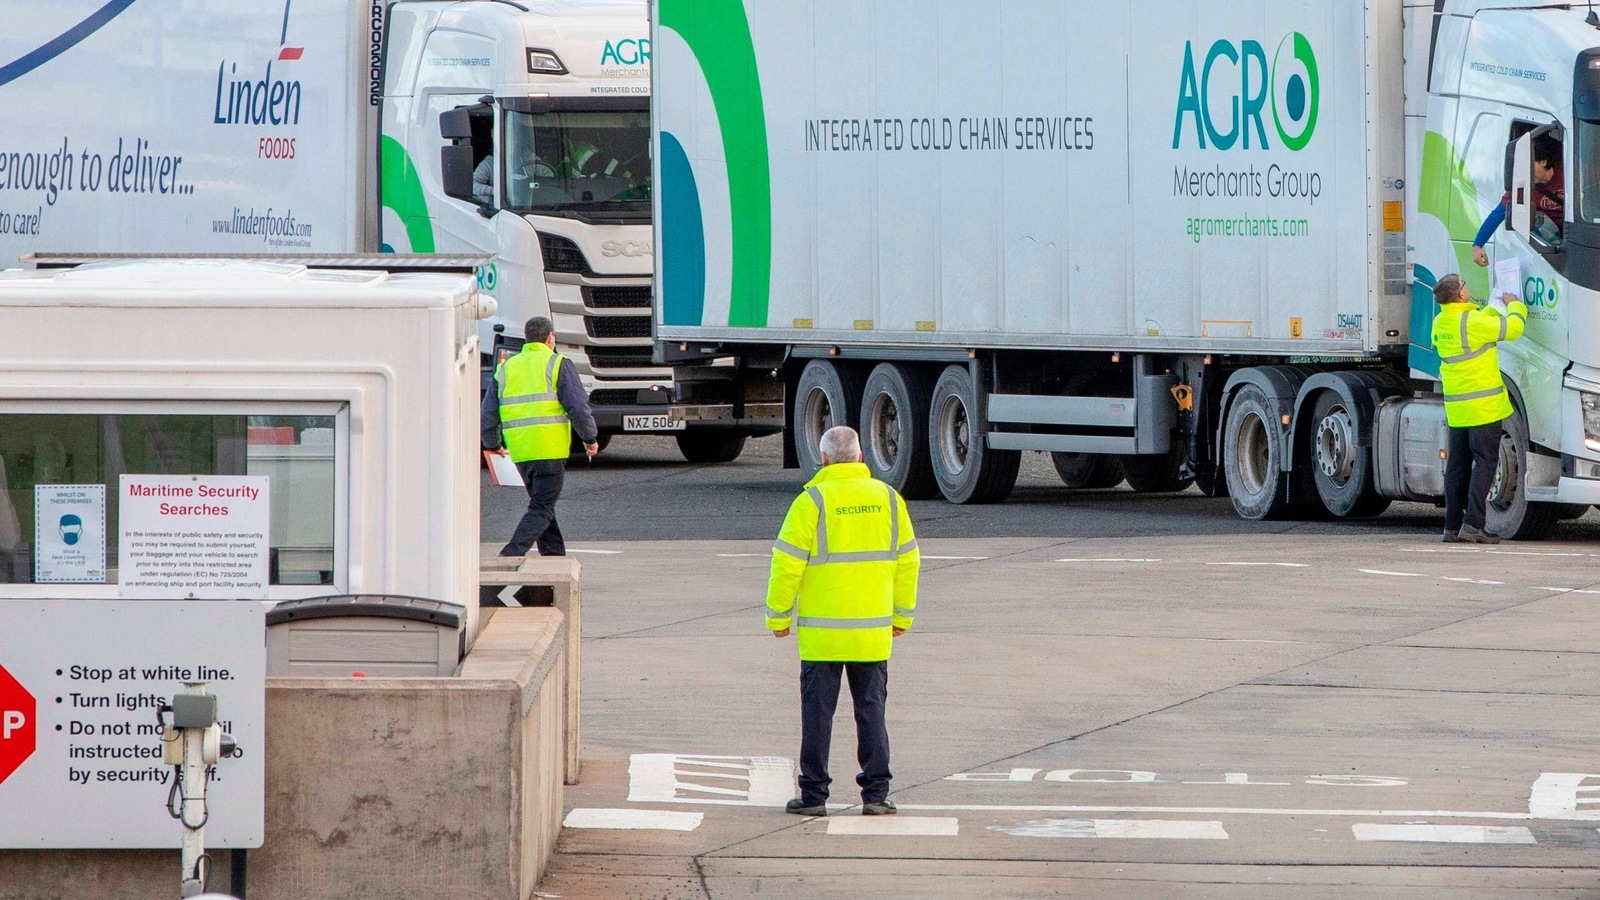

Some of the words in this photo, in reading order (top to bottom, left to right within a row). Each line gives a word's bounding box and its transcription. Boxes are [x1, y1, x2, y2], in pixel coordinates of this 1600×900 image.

[600, 39, 650, 65] AGR
[601, 68, 649, 76] Merchants
[1470, 62, 1496, 74] INTEGRATED
[1496, 66, 1509, 75] COLD
[1509, 68, 1523, 78] CHAIN
[1523, 70, 1546, 81] SERVICES
[213, 59, 301, 125] Linden
[1172, 32, 1319, 151] AGRO
[805, 119, 904, 151] INTEGRATED
[910, 118, 952, 150] COLD
[958, 118, 1008, 150] CHAIN
[1015, 117, 1094, 150] SERVICES
[259, 138, 296, 159] FOODS
[0, 136, 73, 206] enough
[80, 147, 102, 192] to
[108, 137, 194, 194] deliver...
[1173, 164, 1262, 197] Merchants
[1267, 164, 1321, 205] Group
[13, 206, 42, 235] care!
[212, 207, 312, 242] www.lindenfoods.com
[1187, 212, 1308, 243] agromerchants.com
[1525, 277, 1559, 309] GRO
[1337, 314, 1363, 328] DS440T
[1541, 311, 1558, 321] Group
[628, 417, 649, 428] NXZ
[129, 484, 194, 497] Maritime
[198, 485, 259, 500] Security
[160, 503, 229, 516] Searches
[835, 505, 882, 516] SECURITY
[69, 665, 113, 683] Stop
[119, 666, 136, 680] at
[142, 665, 192, 680] white
[198, 665, 235, 680] line.
[69, 693, 110, 707] Turn
[116, 692, 166, 711] lights
[3, 711, 26, 739] P
[70, 720, 95, 735] Do
[101, 721, 131, 735] not
[137, 724, 164, 735] mo
[69, 743, 163, 759] instructed
[69, 766, 91, 785] by
[96, 766, 170, 785] security
